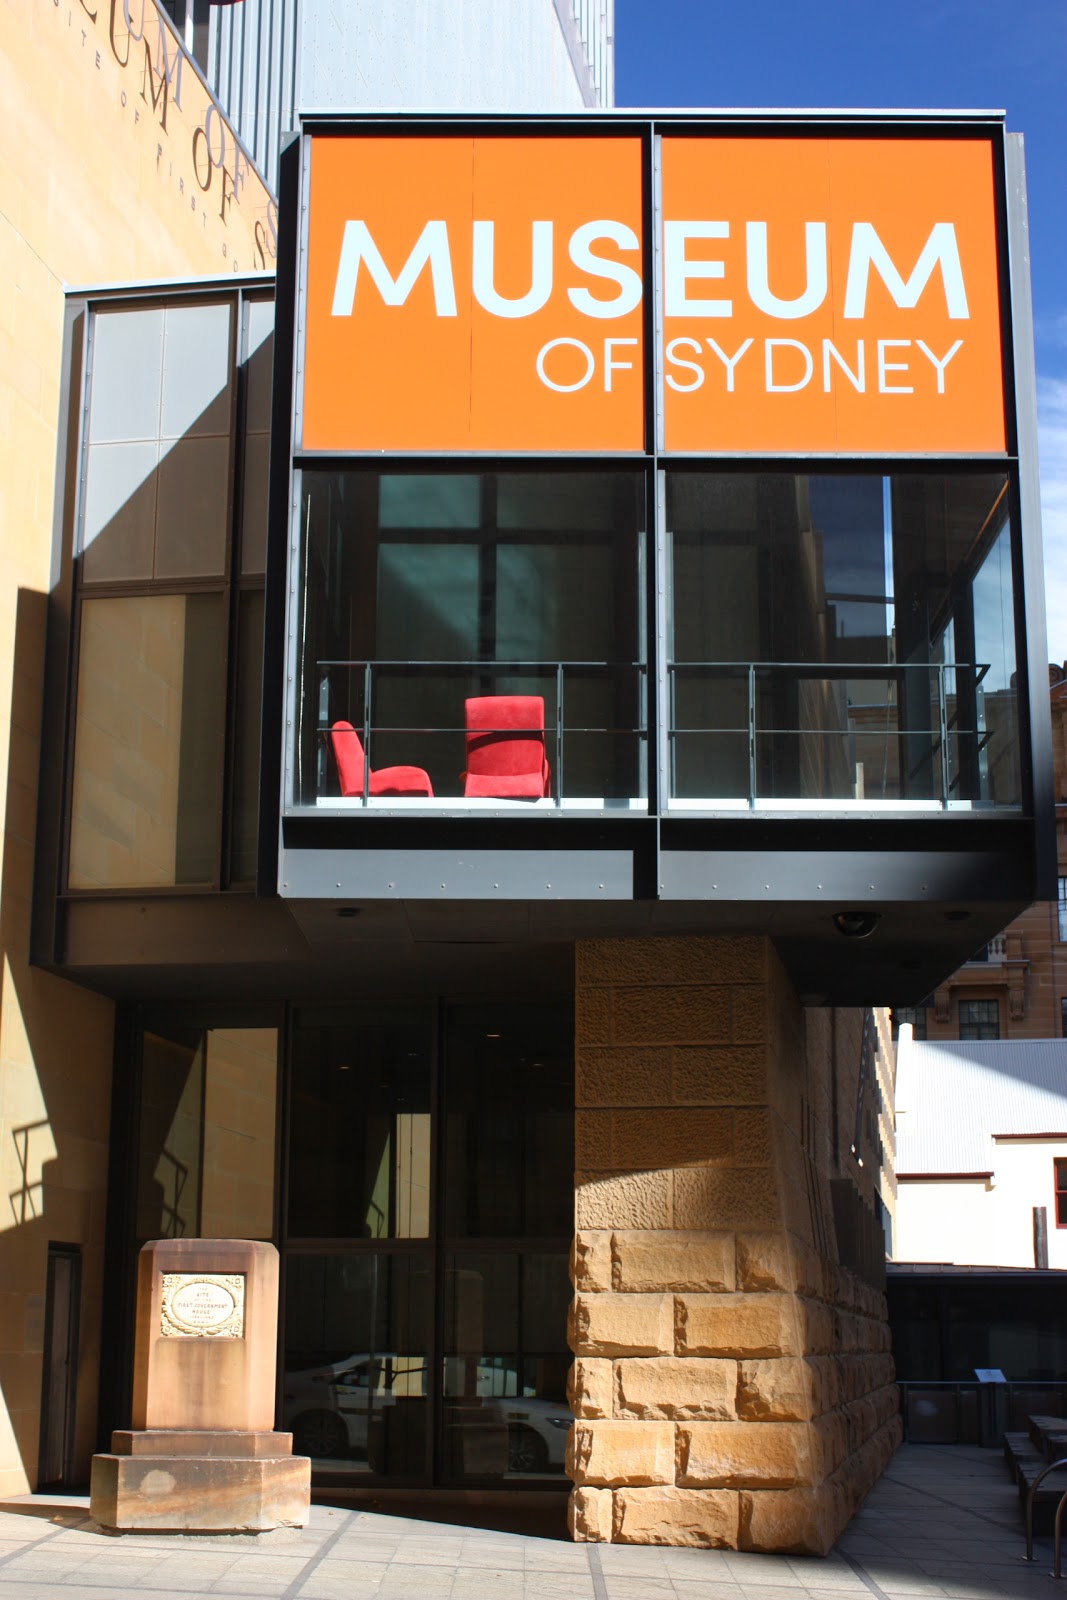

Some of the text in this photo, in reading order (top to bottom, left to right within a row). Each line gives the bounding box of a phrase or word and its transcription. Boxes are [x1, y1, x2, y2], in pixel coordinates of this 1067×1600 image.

[331, 220, 970, 320] MUSEUM
[536, 337, 964, 394] OF SYDNEY
